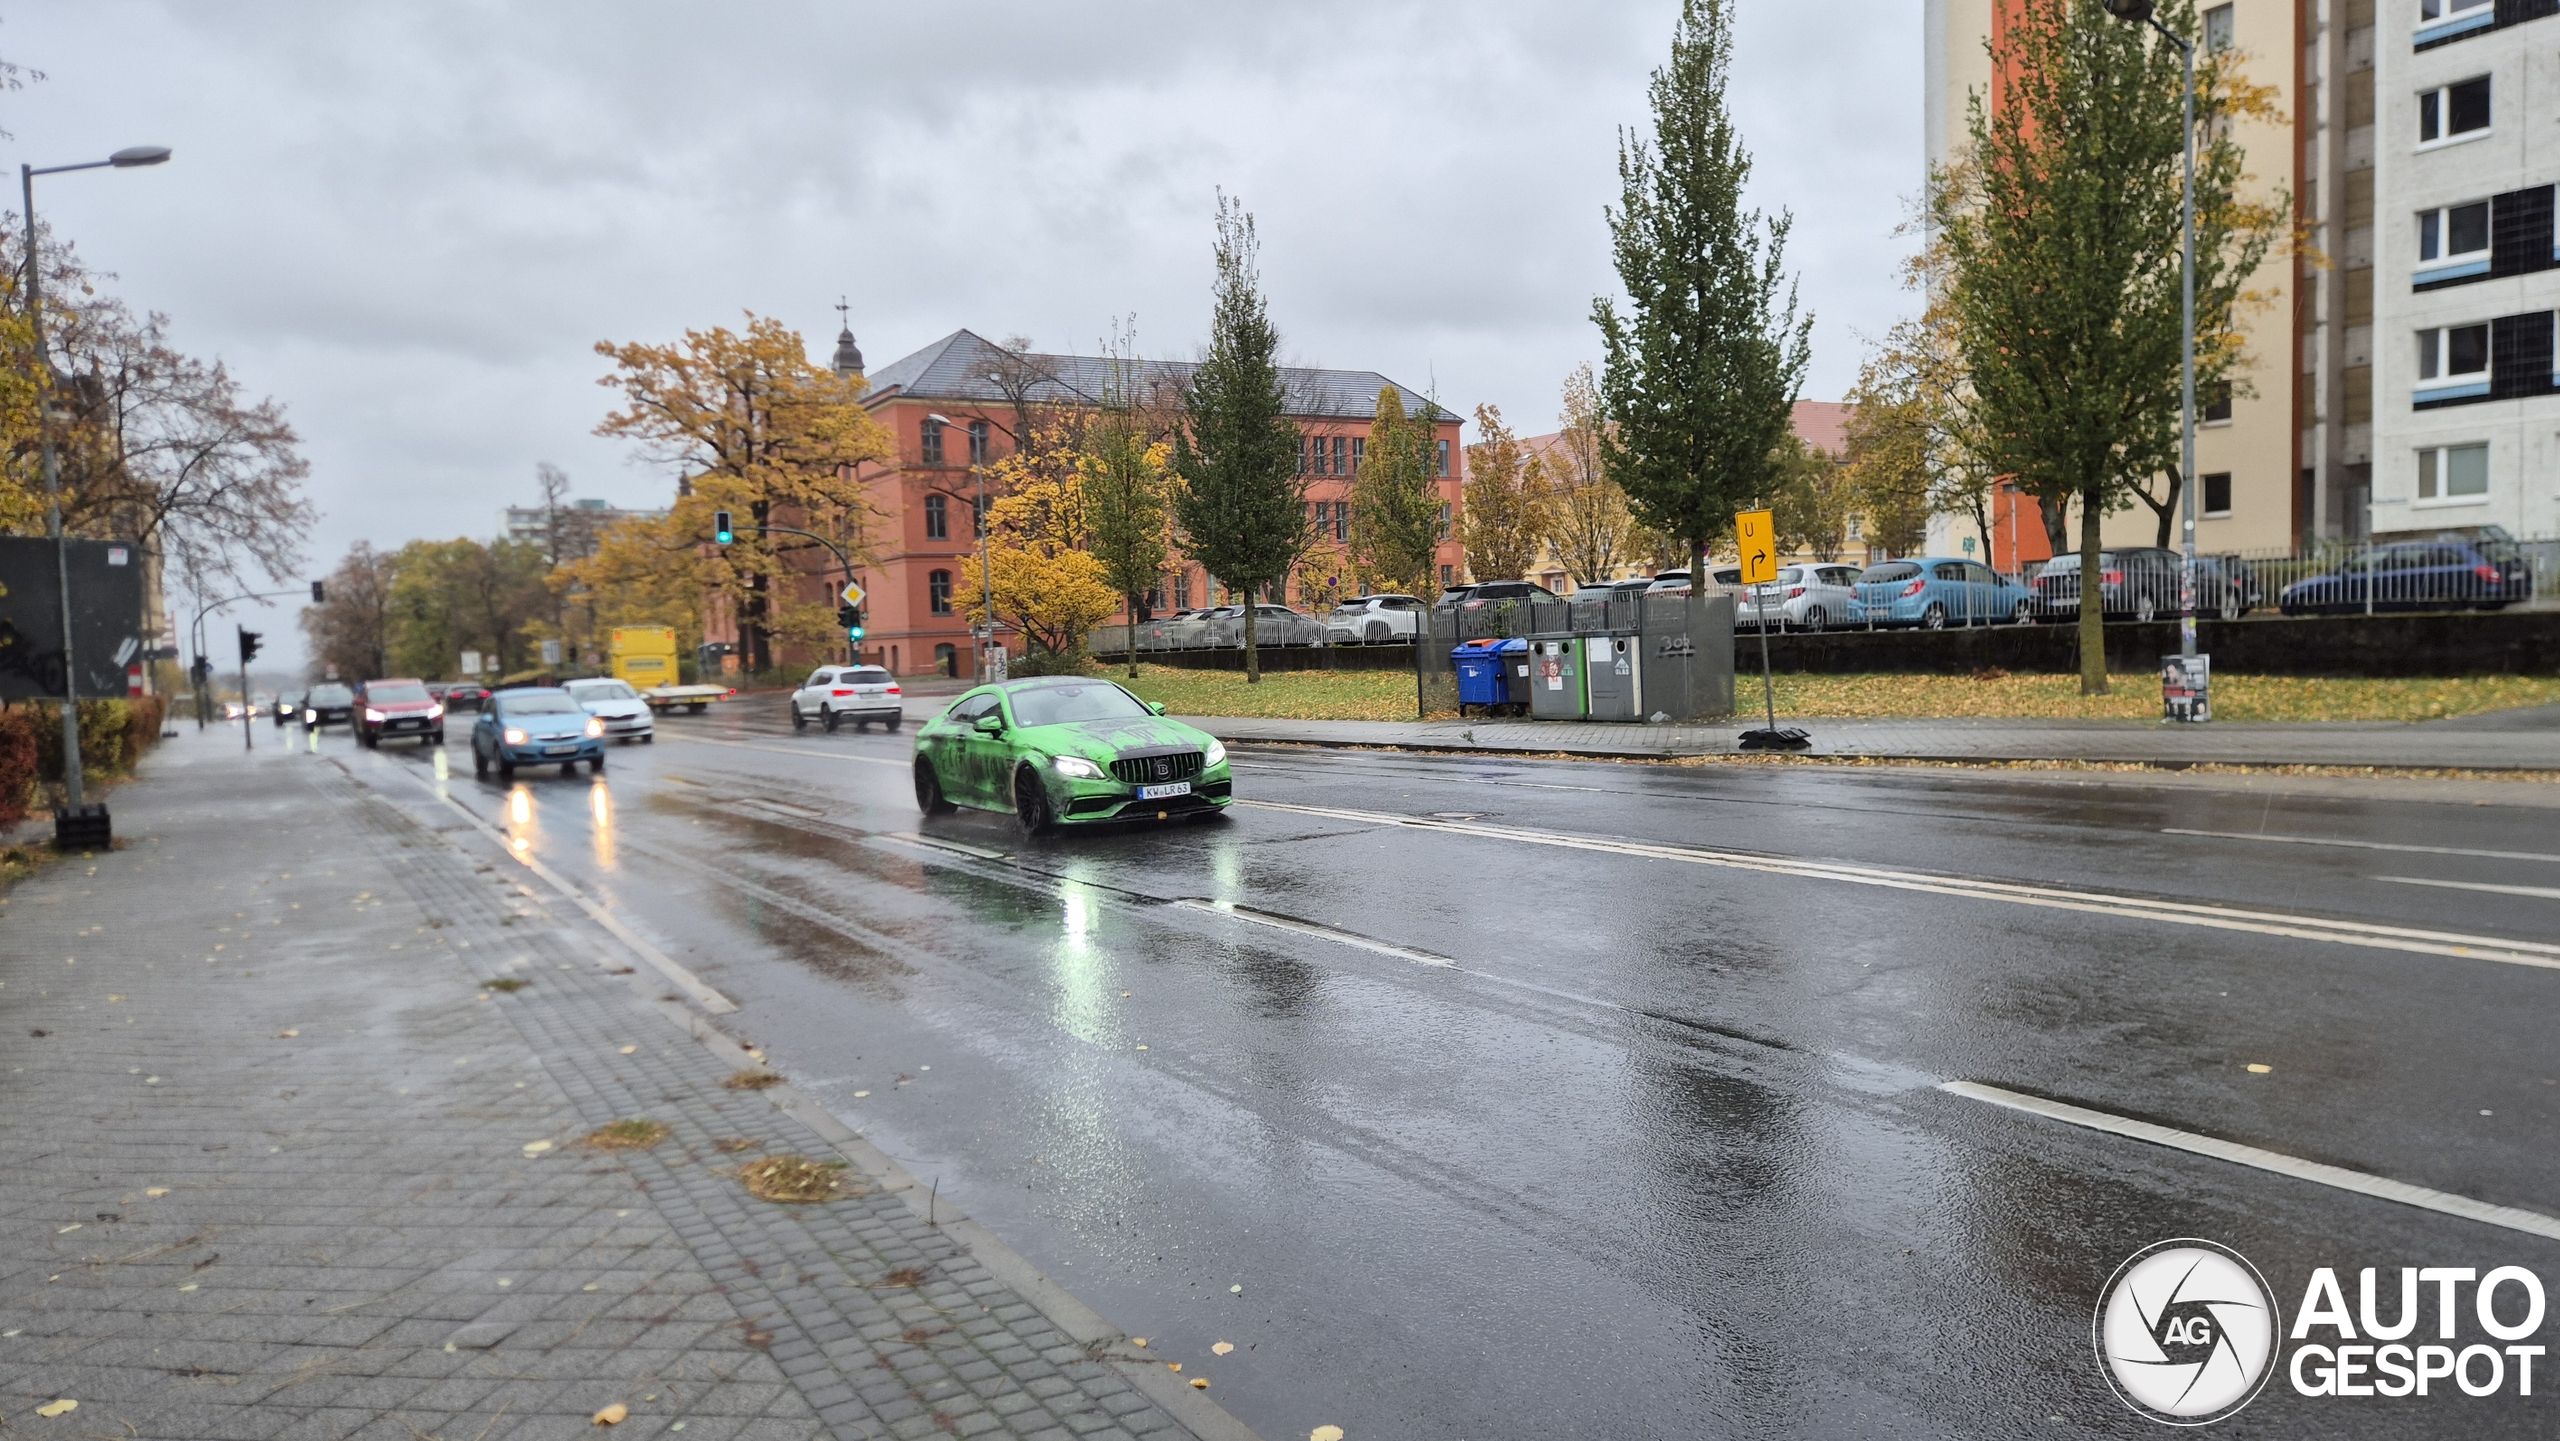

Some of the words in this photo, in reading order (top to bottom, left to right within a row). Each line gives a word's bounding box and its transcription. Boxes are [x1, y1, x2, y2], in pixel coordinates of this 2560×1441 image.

[1744, 522, 1754, 537] U
[1614, 668, 1630, 676] GLAS
[1157, 764, 1169, 775] B
[1147, 787, 1159, 797] KW
[1164, 785, 1176, 795] LR
[1177, 783, 1188, 793] 63
